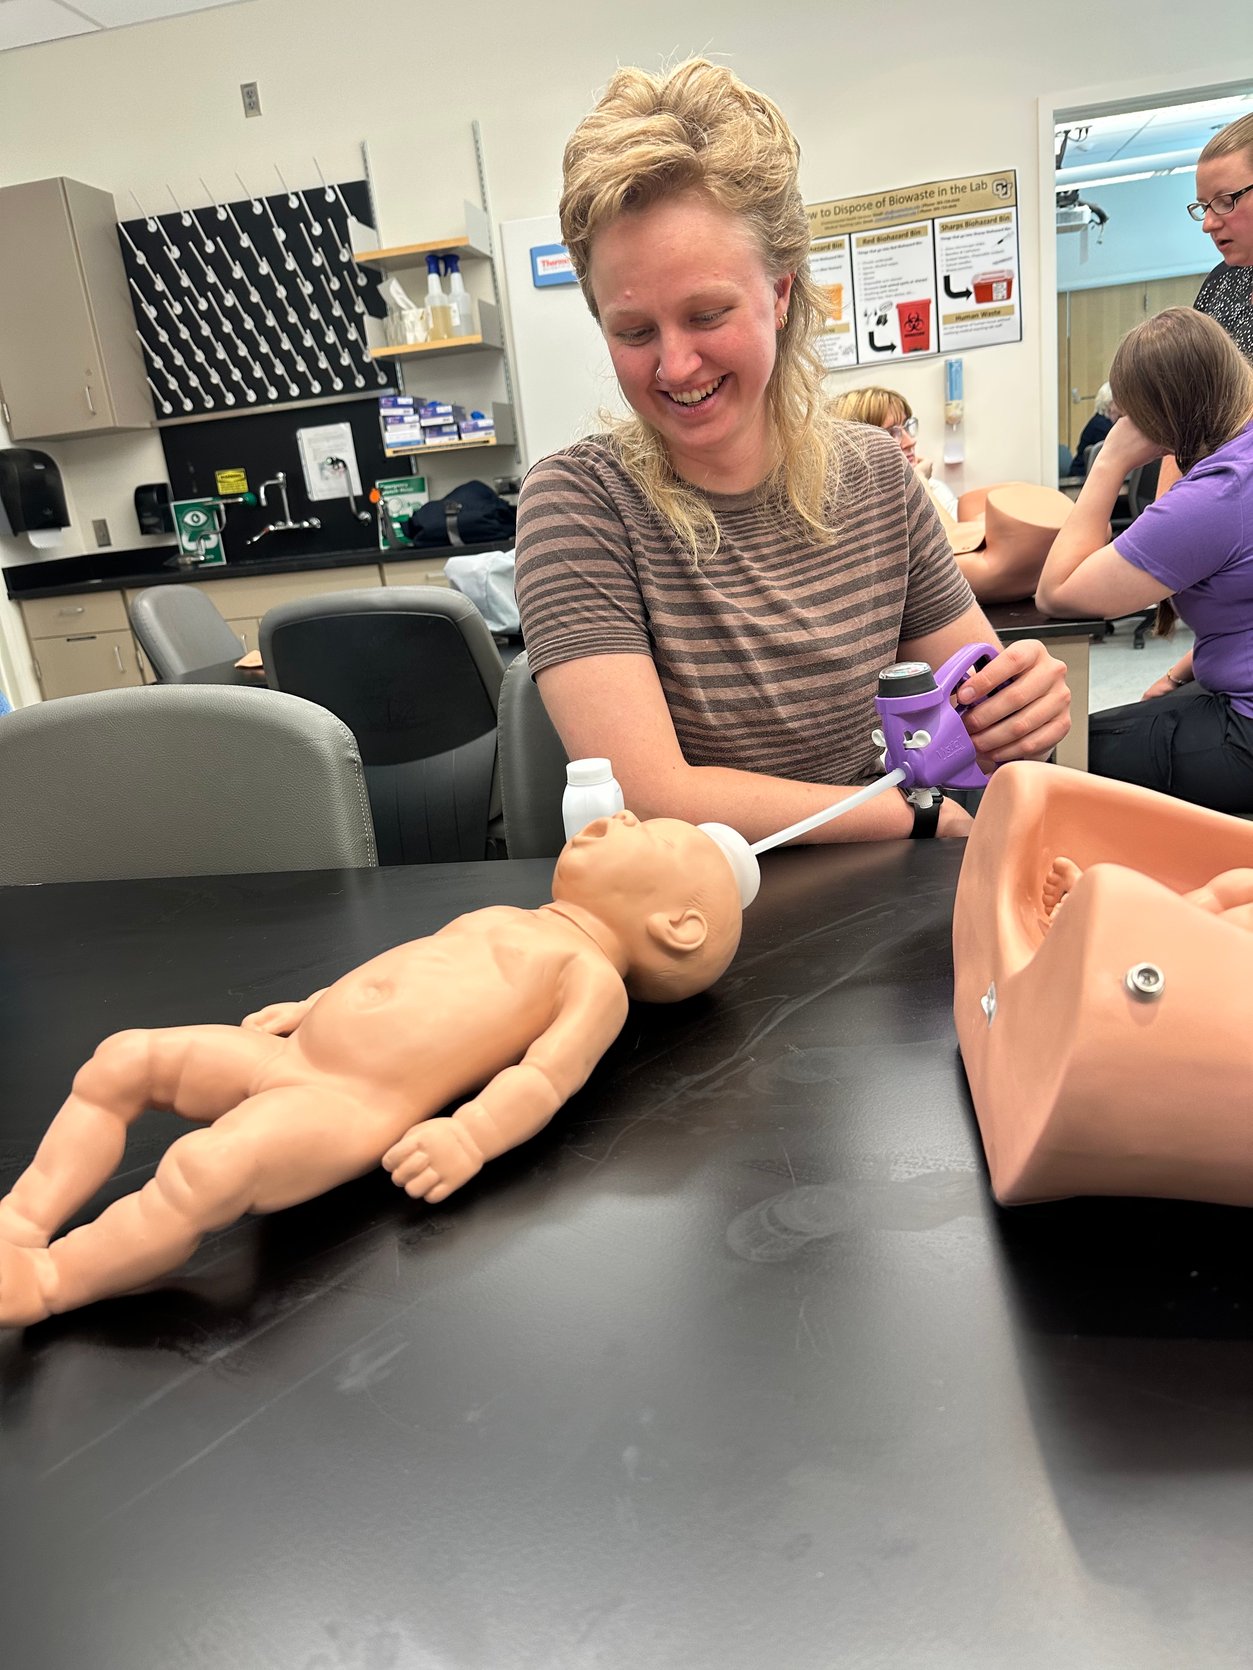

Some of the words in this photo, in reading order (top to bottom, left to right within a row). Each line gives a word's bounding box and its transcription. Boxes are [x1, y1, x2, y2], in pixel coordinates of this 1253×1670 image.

[820, 208, 831, 218] to
[833, 202, 873, 216] Dispose
[875, 197, 887, 209] of
[889, 189, 935, 206] Biowaste
[937, 186, 948, 197] in
[950, 183, 967, 195] the
[969, 180, 988, 192] Lab
[940, 222, 963, 231] Sharps
[964, 216, 998, 228] Biohazard
[999, 214, 1010, 222] Bin
[862, 236, 875, 245] Red
[876, 230, 908, 243] Biohazard
[909, 229, 921, 237] Bin
[954, 312, 979, 322] Human
[980, 309, 1001, 319] Waste
